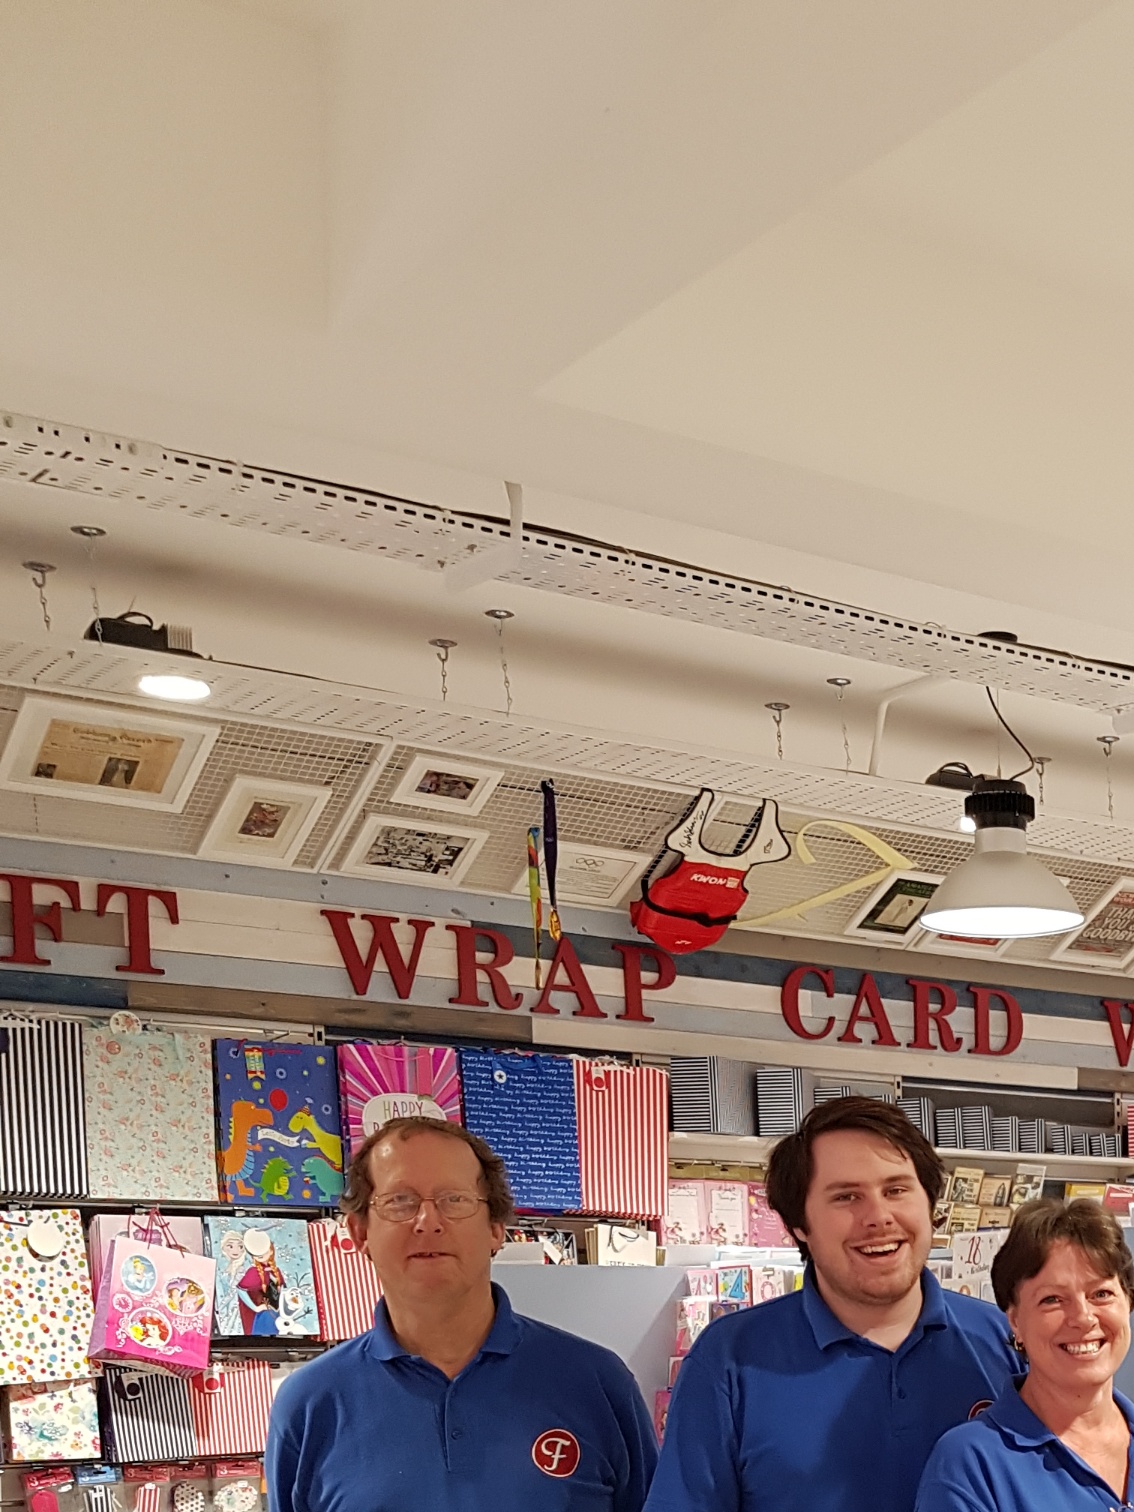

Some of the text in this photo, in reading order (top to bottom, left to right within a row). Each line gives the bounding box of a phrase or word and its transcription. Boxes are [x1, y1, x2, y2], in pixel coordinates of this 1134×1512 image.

[690, 873, 727, 886] KWON
[1102, 917, 1128, 930] YOU
[320, 909, 678, 1022] WRAP
[780, 966, 1024, 1057] CARD
[383, 1100, 424, 1120] HAPPY
[964, 1235, 982, 1266] 18
[728, 1268, 746, 1300] 4
